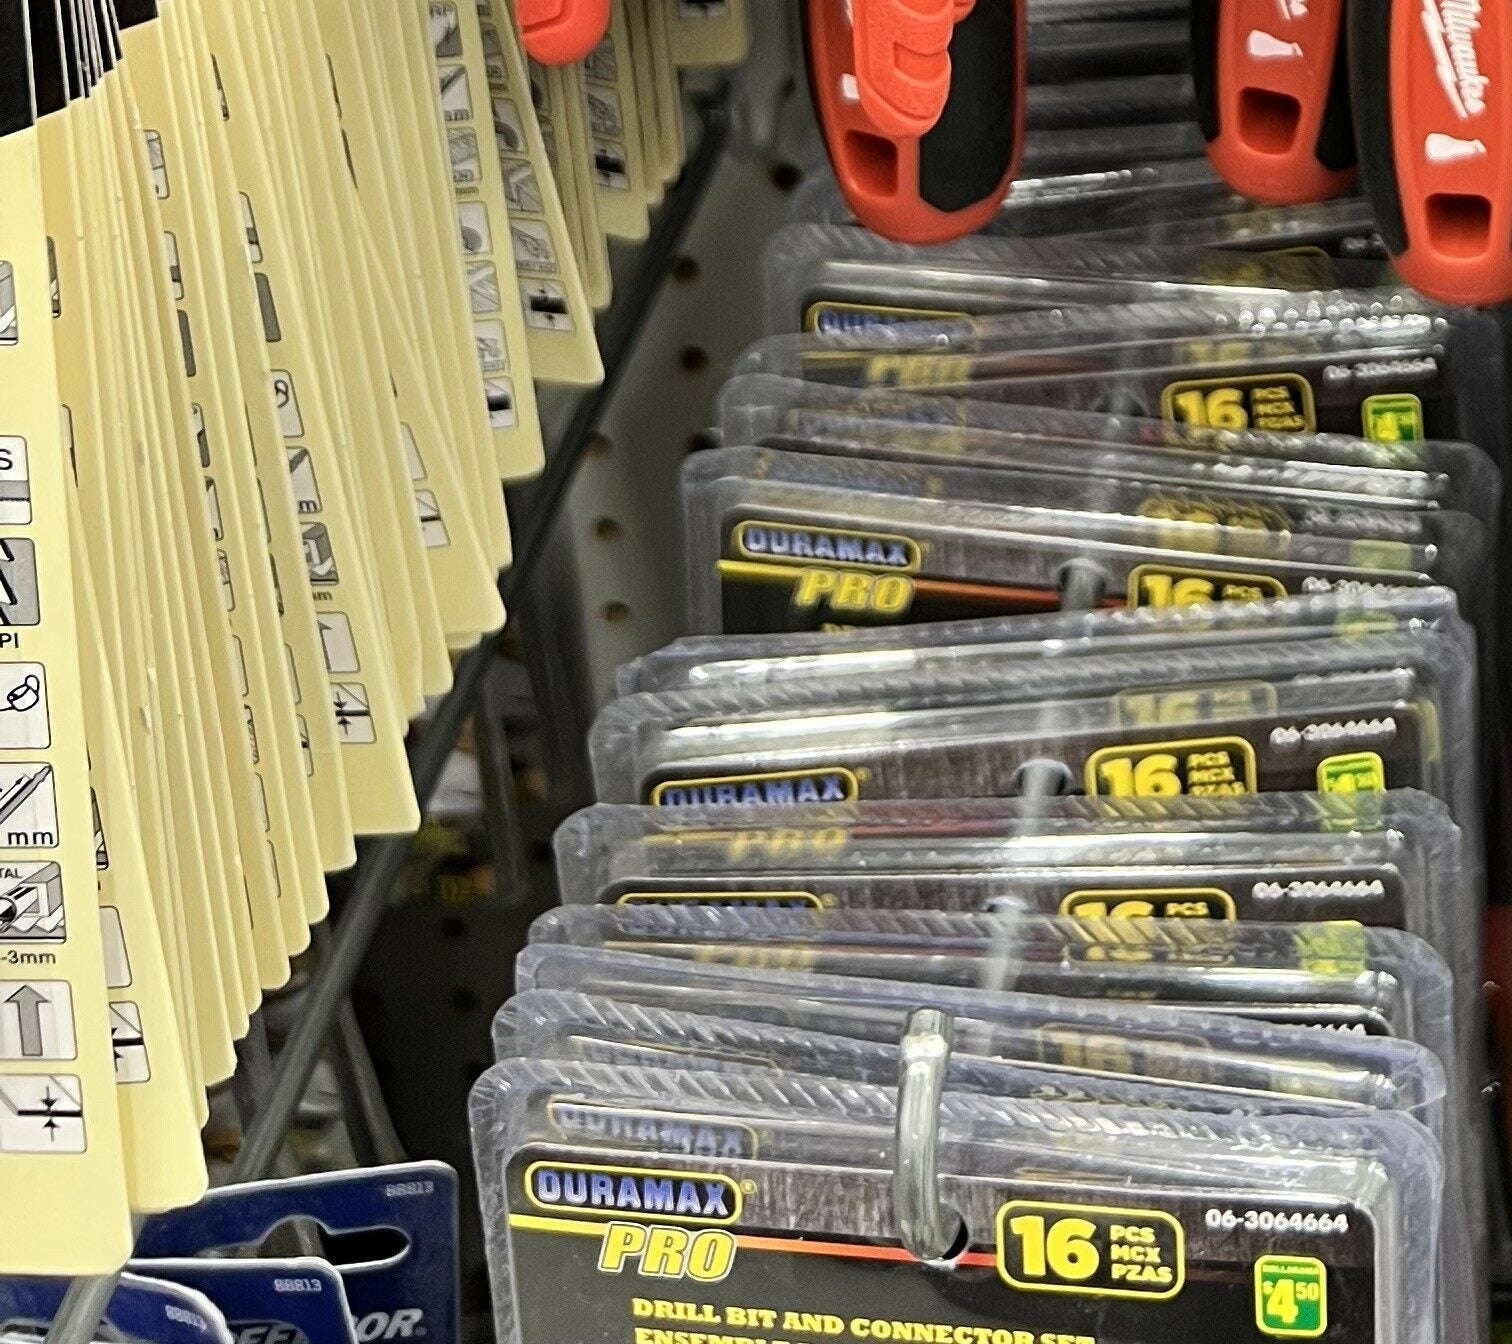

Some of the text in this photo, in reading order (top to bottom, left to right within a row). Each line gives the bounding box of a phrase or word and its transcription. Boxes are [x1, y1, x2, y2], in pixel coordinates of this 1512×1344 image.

[744, 528, 908, 566] DURAMAX
[793, 569, 916, 612] PRO
[7, 831, 54, 846] mm
[537, 1169, 730, 1216] DURAMAX
[1110, 1224, 1156, 1244] PCS
[1206, 1208, 1349, 1234] 06-3064664
[598, 1220, 737, 1282] PRO
[1010, 1214, 1100, 1280] 16
[1110, 1244, 1162, 1263] MCX
[1110, 1263, 1173, 1284] PZAS
[632, 1296, 722, 1324] DRILL
[726, 1306, 778, 1328] BIT
[784, 1311, 845, 1335] AND
